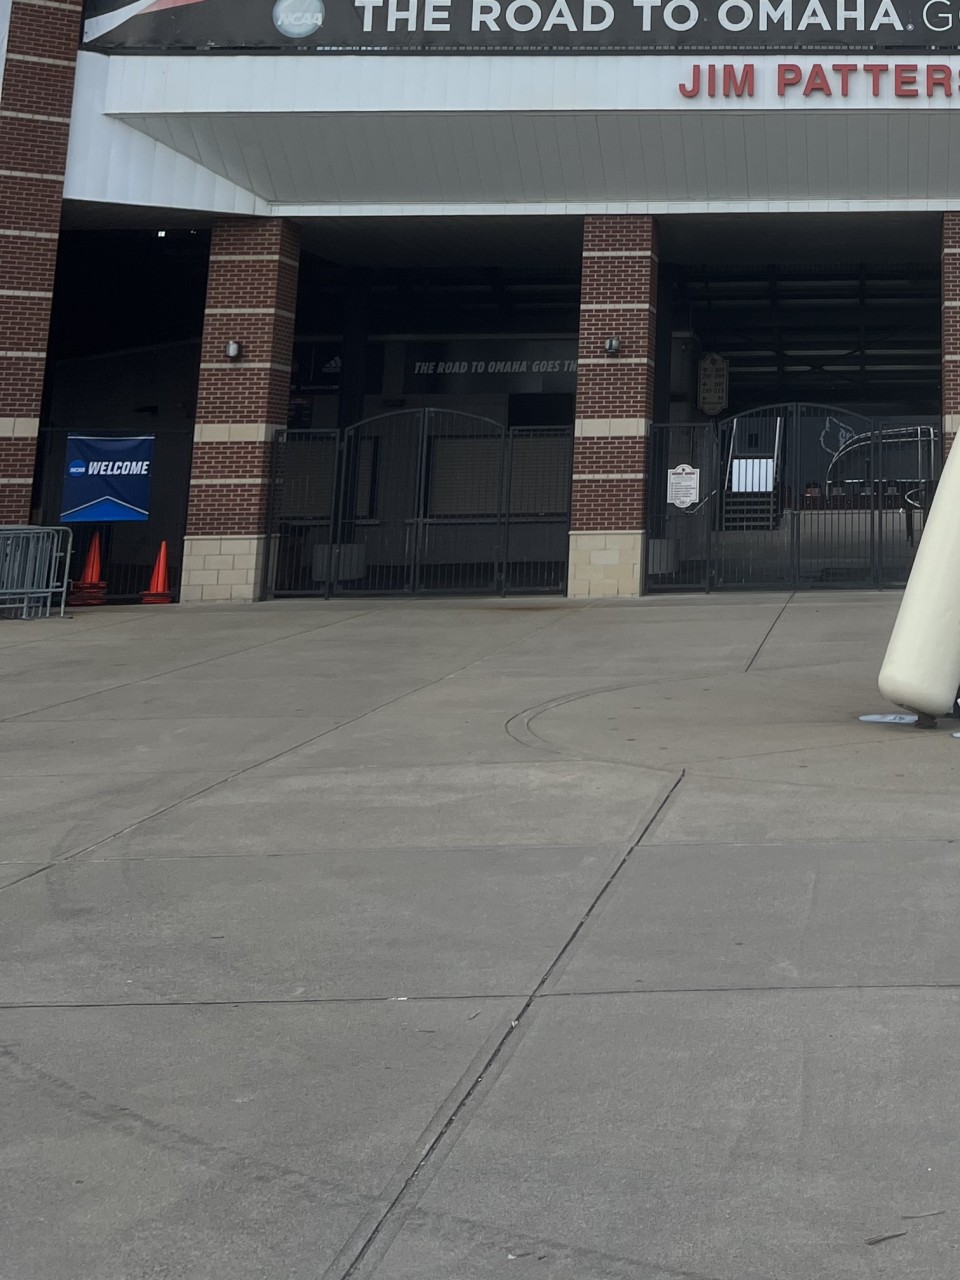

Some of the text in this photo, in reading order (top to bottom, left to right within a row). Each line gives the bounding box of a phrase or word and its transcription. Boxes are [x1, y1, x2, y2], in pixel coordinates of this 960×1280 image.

[277, 12, 323, 26] NCAA
[679, 63, 755, 98] JIM
[414, 362, 435, 374] THE
[437, 361, 468, 374] ROAD
[471, 361, 485, 373] TO
[532, 360, 560, 373] GOES
[87, 461, 151, 475] WELCOME
